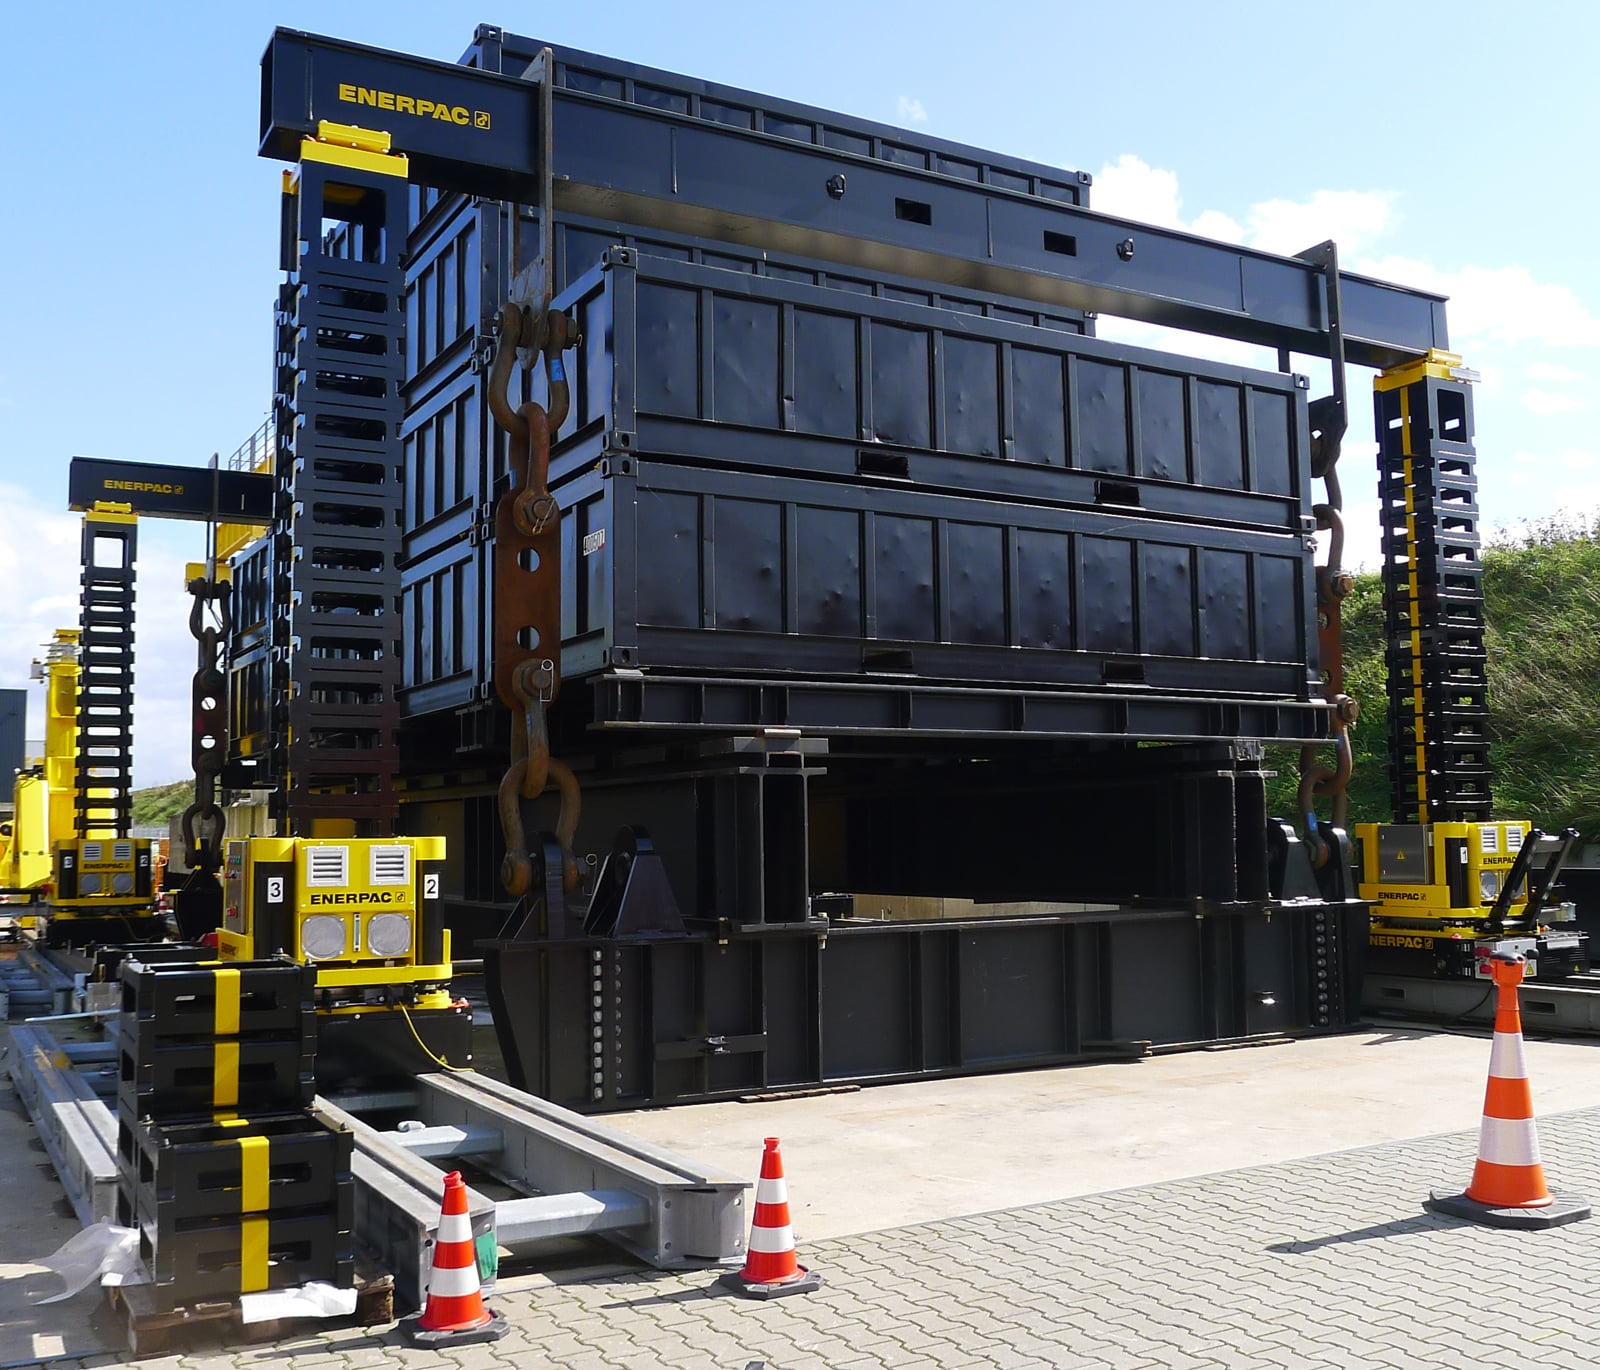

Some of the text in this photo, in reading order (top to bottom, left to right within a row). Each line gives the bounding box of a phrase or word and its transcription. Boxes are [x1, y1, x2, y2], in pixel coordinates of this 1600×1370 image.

[338, 83, 470, 125] ENERPAC
[104, 480, 172, 493] ENERPAC
[270, 882, 281, 897] 3
[426, 879, 436, 894] 2
[310, 892, 392, 905] ENERPAC
[1378, 892, 1419, 900] ENERPAC
[1369, 935, 1422, 949] NERPAC
